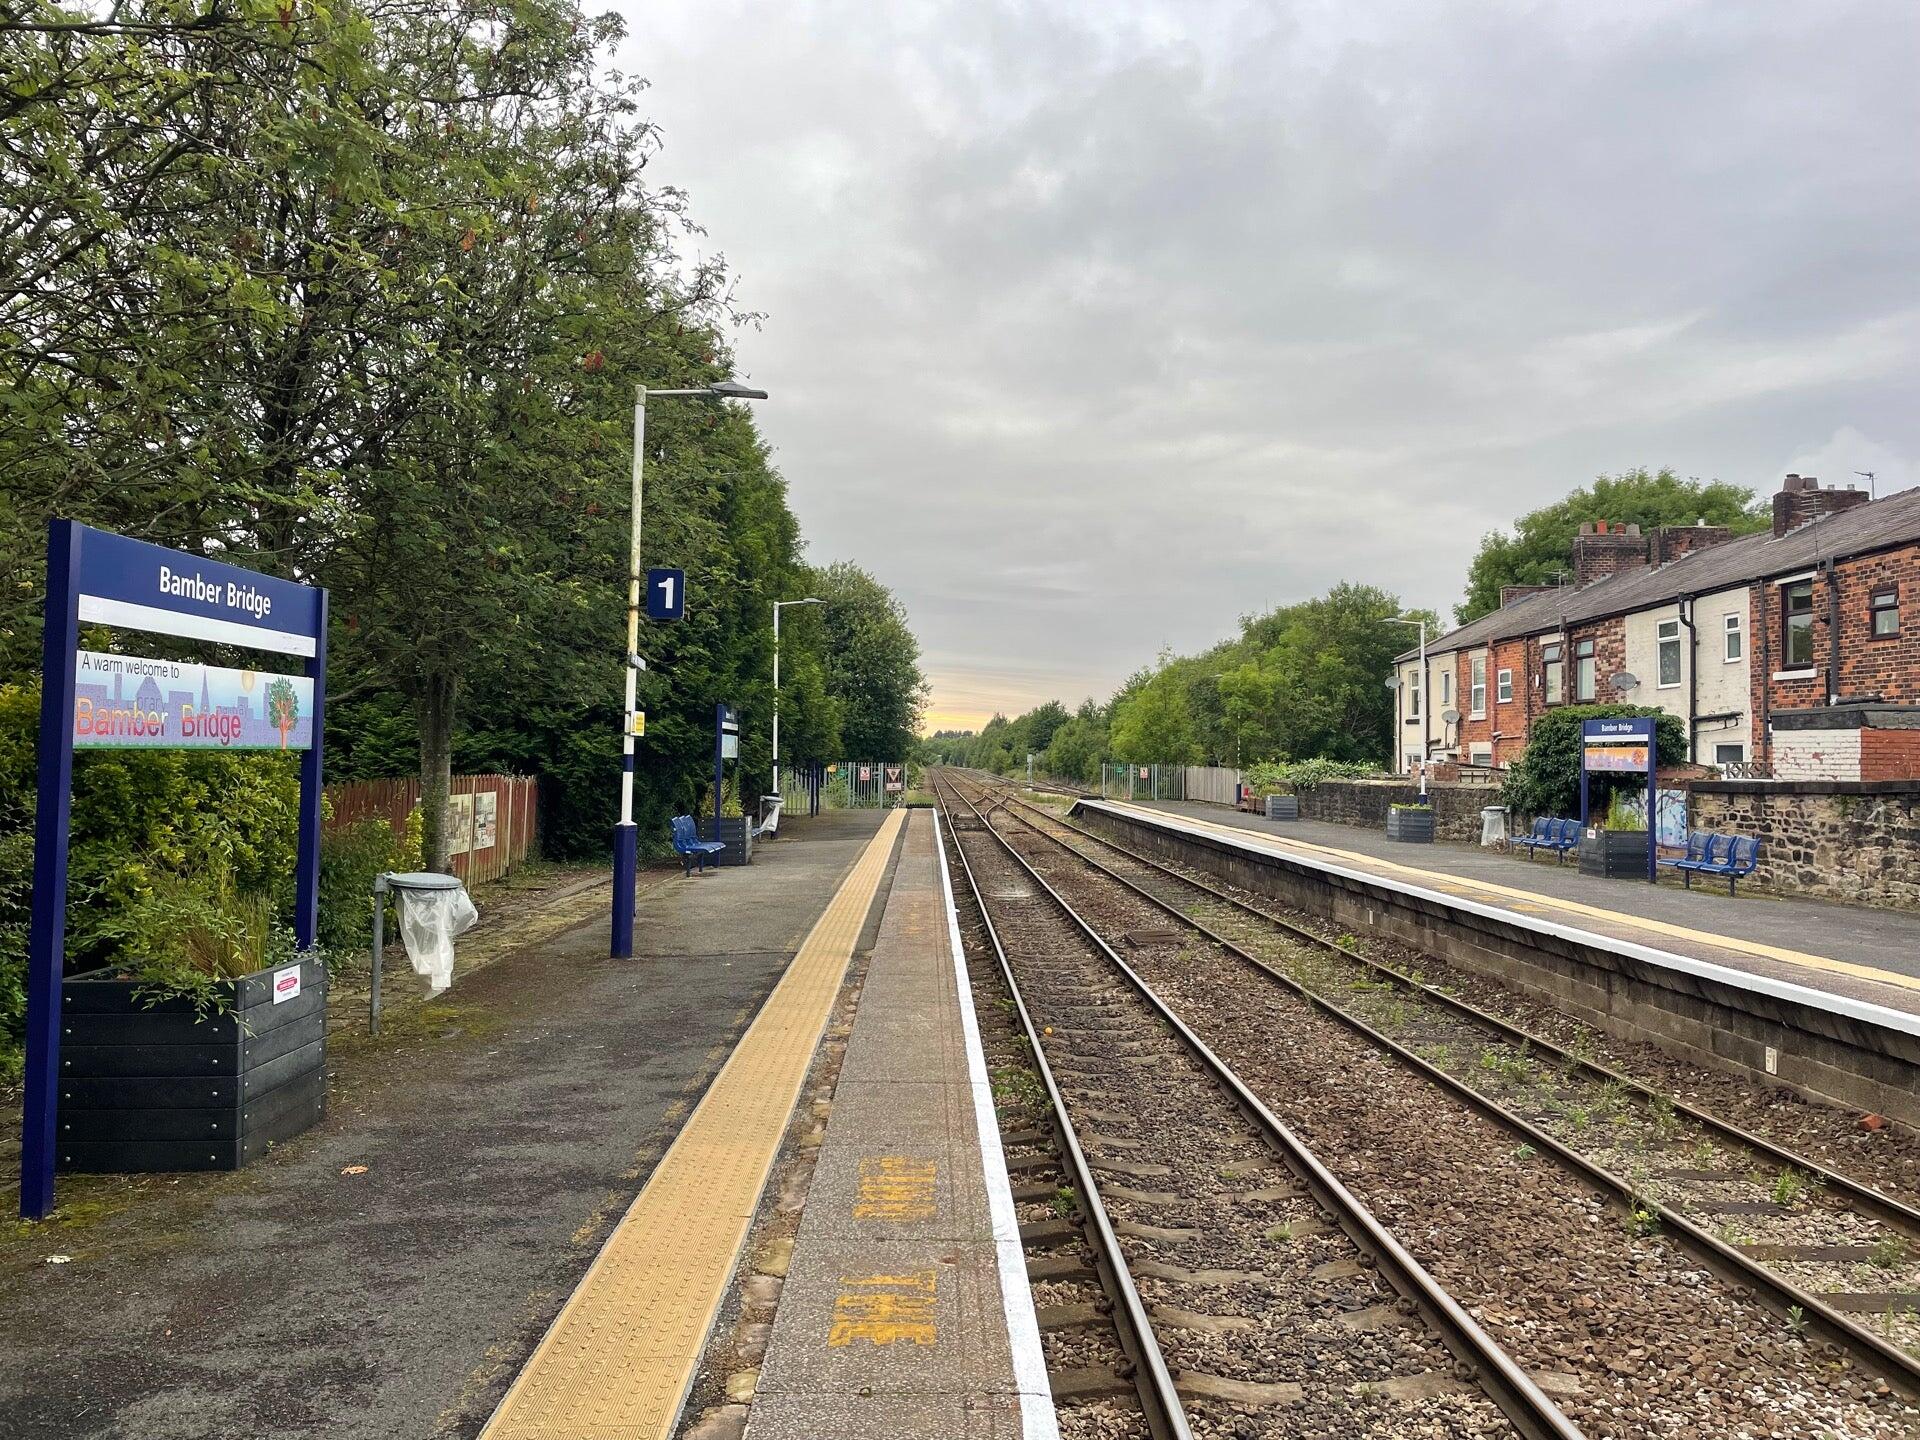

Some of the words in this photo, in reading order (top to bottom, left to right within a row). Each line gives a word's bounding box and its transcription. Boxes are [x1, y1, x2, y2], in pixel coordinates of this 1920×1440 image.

[159, 565, 222, 604] Bamber
[226, 582, 272, 619] Bridge
[657, 577, 675, 609] 1
[81, 653, 91, 669] A
[93, 657, 123, 673] warm
[126, 660, 168, 678] welcome
[170, 664, 180, 679] to
[75, 696, 169, 736] Bamber
[181, 703, 242, 746] Bridge
[1601, 724, 1618, 732] Bamber
[1618, 723, 1633, 733] Bridge
